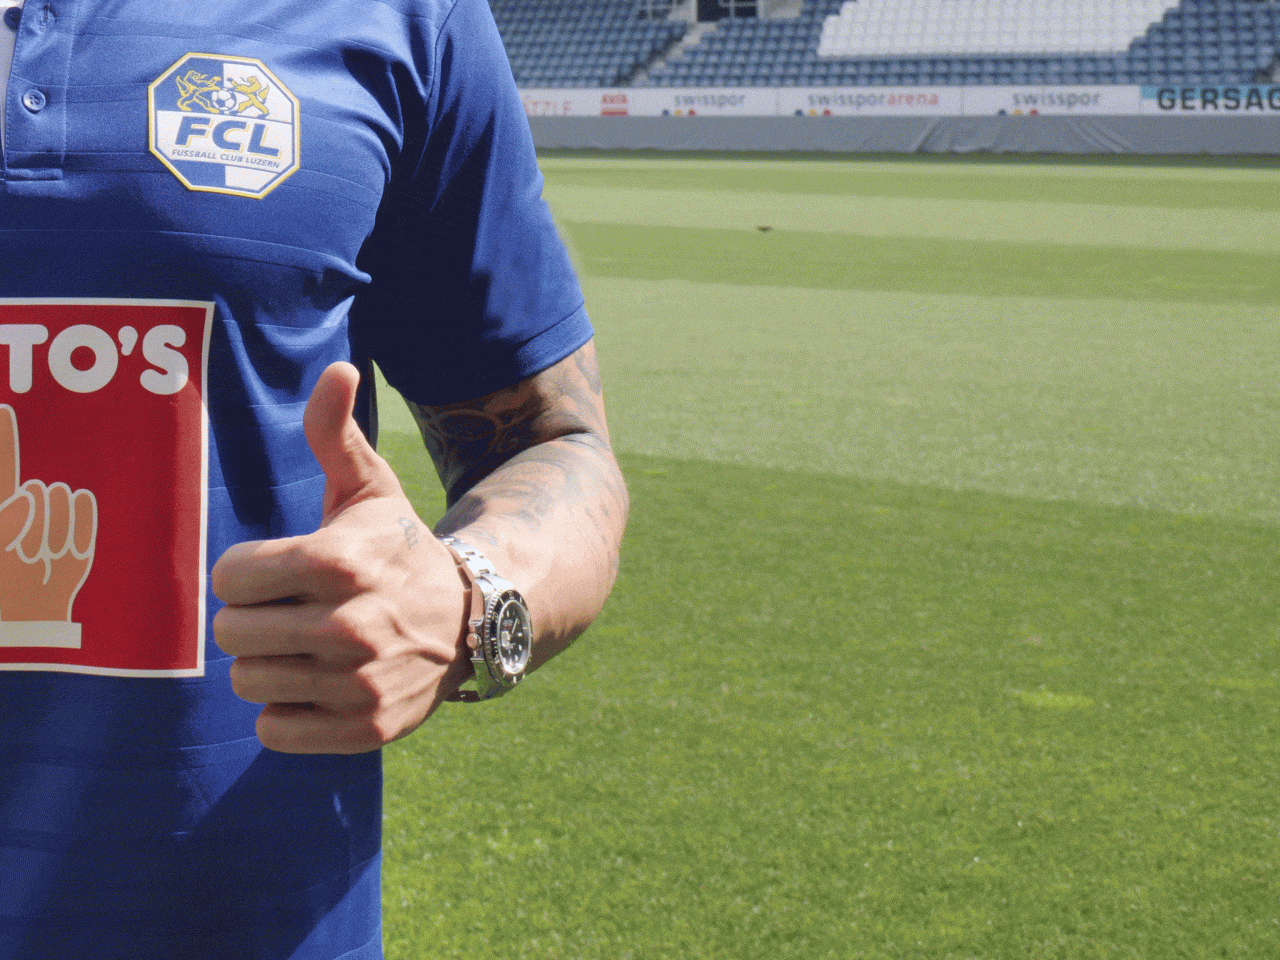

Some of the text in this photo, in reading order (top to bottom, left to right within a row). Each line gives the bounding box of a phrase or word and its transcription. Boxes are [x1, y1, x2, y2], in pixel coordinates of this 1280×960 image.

[674, 95, 745, 109] swisspor
[1012, 93, 1100, 110] swisspor
[175, 116, 280, 158] FCL
[171, 149, 280, 168] FUSSBALL CLUB LUZERN
